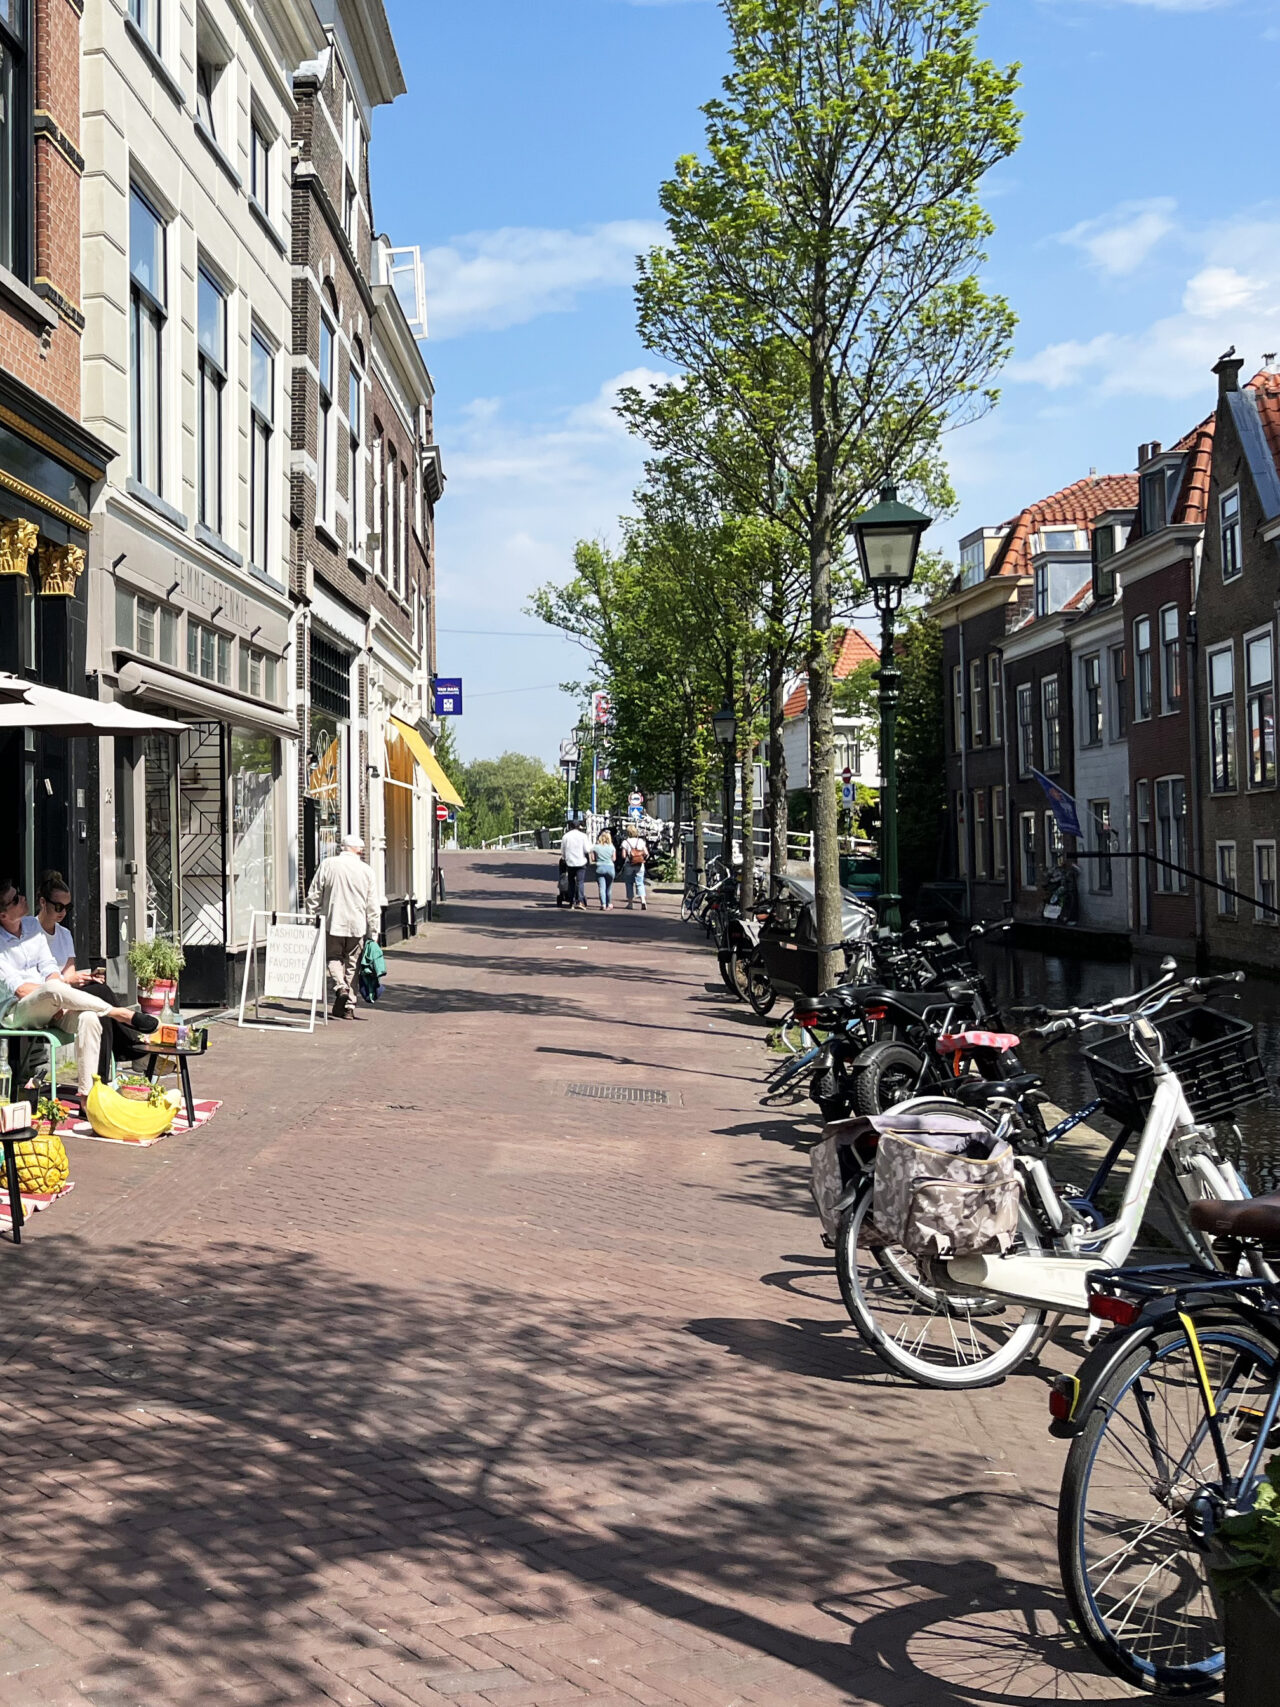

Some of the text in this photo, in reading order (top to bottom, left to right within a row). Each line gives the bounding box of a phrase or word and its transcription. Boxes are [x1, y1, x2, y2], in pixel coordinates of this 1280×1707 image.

[269, 928, 316, 940] FASHION IS
[269, 943, 281, 952] MY
[268, 957, 306, 969] FAVORITE
[268, 972, 302, 984] F-WORD
